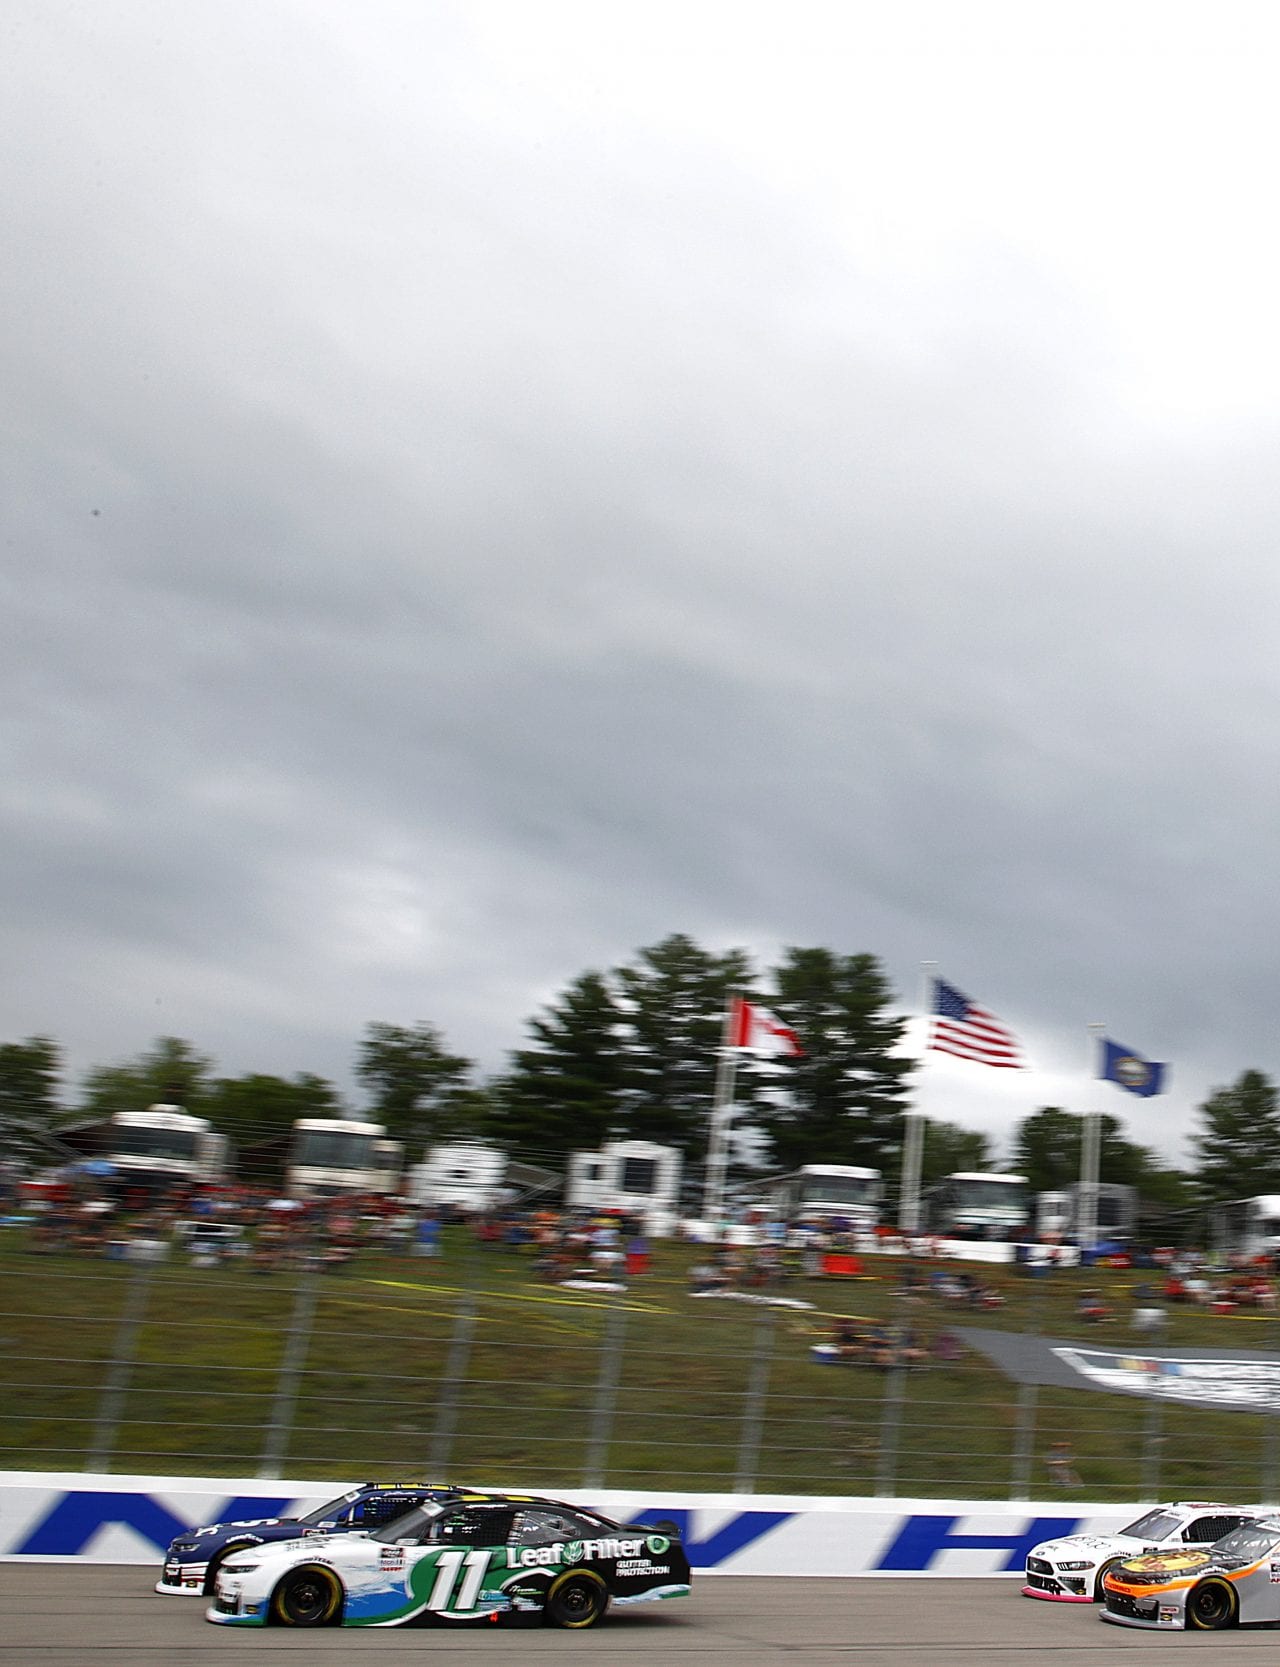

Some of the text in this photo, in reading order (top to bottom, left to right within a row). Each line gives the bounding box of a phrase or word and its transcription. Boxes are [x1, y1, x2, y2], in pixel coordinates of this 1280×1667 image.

[507, 1538, 645, 1568] Leaf Filter
[616, 1559, 652, 1568] GUTTER
[616, 1566, 670, 1577] PROTECTION
[427, 1551, 492, 1610] 11
